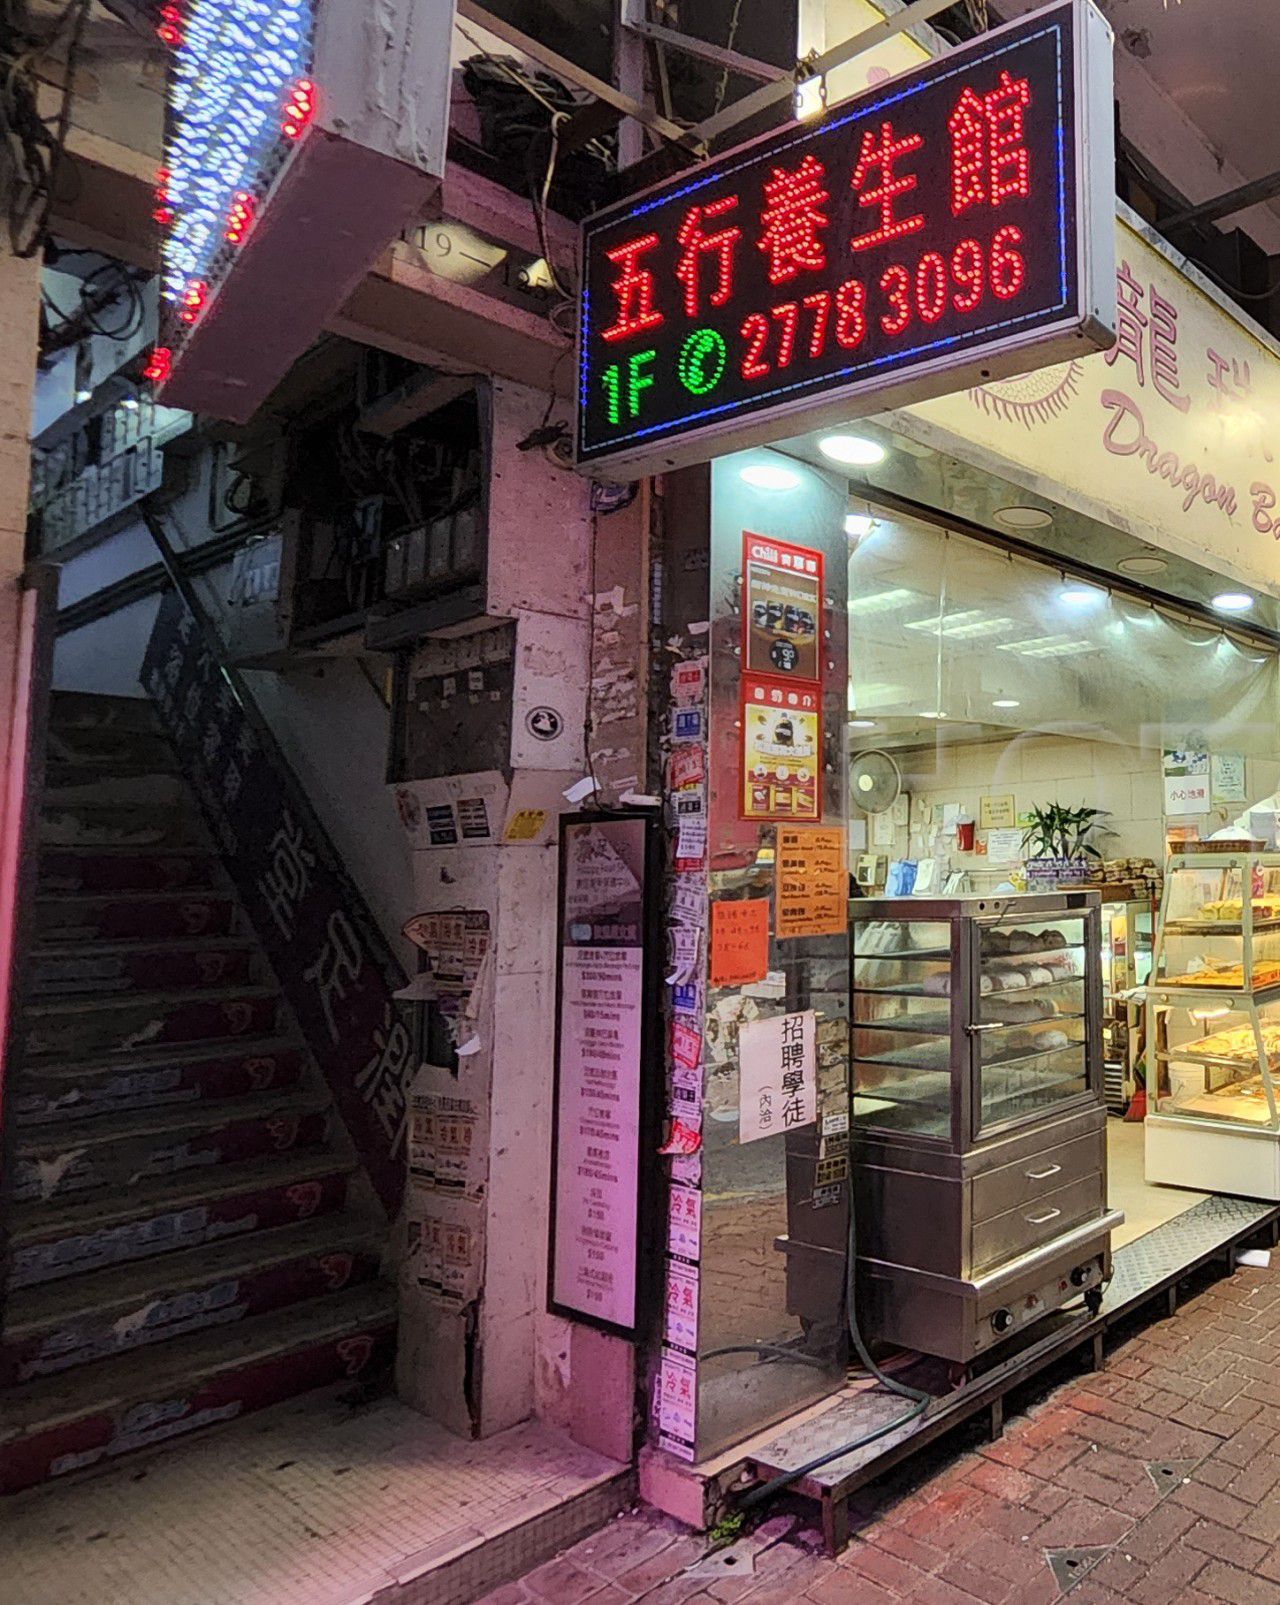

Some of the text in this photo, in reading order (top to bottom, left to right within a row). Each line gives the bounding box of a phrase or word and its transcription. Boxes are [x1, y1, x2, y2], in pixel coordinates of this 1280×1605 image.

[600, 71, 1031, 342] 五行養生館
[601, 225, 1026, 425] 1F 2778 3096
[1101, 388, 1238, 516] Dragon
[781, 1015, 806, 1127] 招聘學徒
